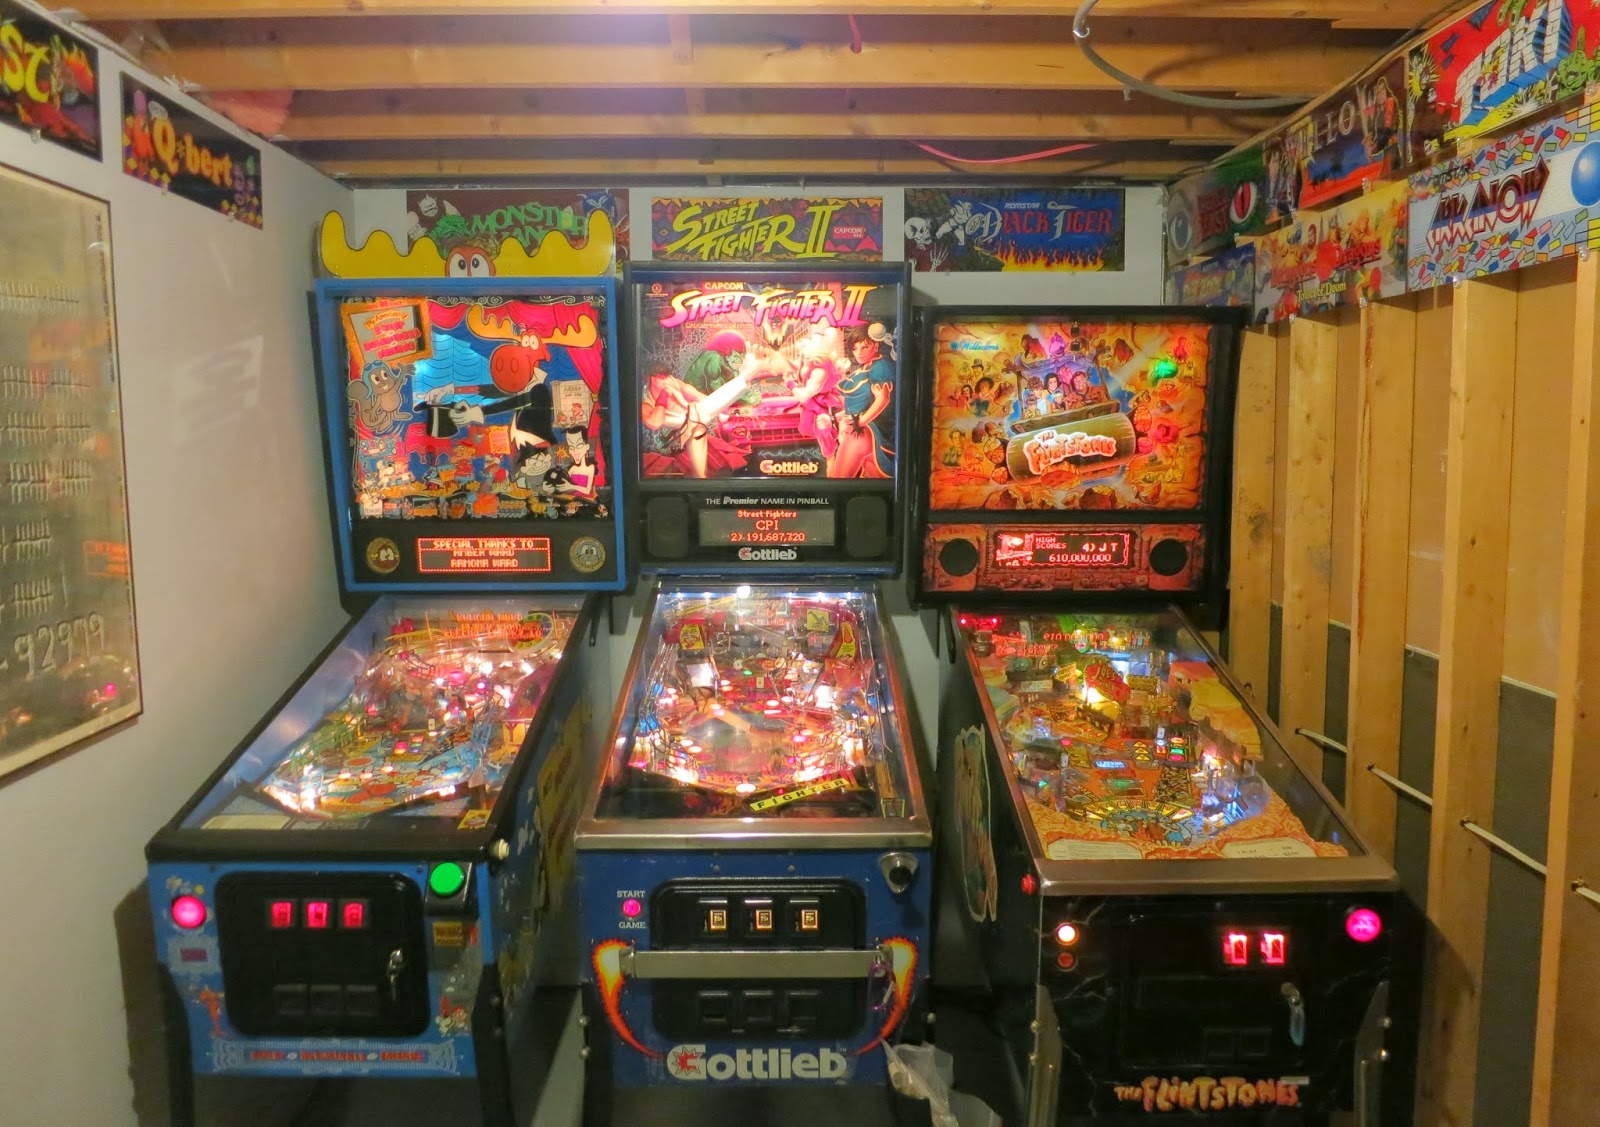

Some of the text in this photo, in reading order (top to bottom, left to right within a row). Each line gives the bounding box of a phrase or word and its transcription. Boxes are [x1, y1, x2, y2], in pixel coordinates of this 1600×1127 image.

[666, 202, 760, 255] STREET
[692, 205, 845, 260] FIGHTER II
[659, 285, 878, 329] STREET FIGHTER II
[760, 460, 818, 474] Gottlieb
[723, 496, 759, 505] Premier
[755, 520, 779, 531] CPI
[731, 533, 805, 542] 2) 191,687,320
[433, 540, 534, 548] SPECIAL THANKS TO
[1082, 543, 1096, 552] 4)
[738, 547, 798, 561] Gottlieb
[1049, 554, 1111, 563] 610,000,000
[450, 559, 518, 568] RAMONA WARD
[757, 779, 845, 810] FIGHTER
[616, 890, 646, 898] START
[618, 921, 646, 929] GAME
[667, 1044, 847, 1080] Gottlieb
[1114, 1076, 1298, 1112] THE FLINTSTONES
